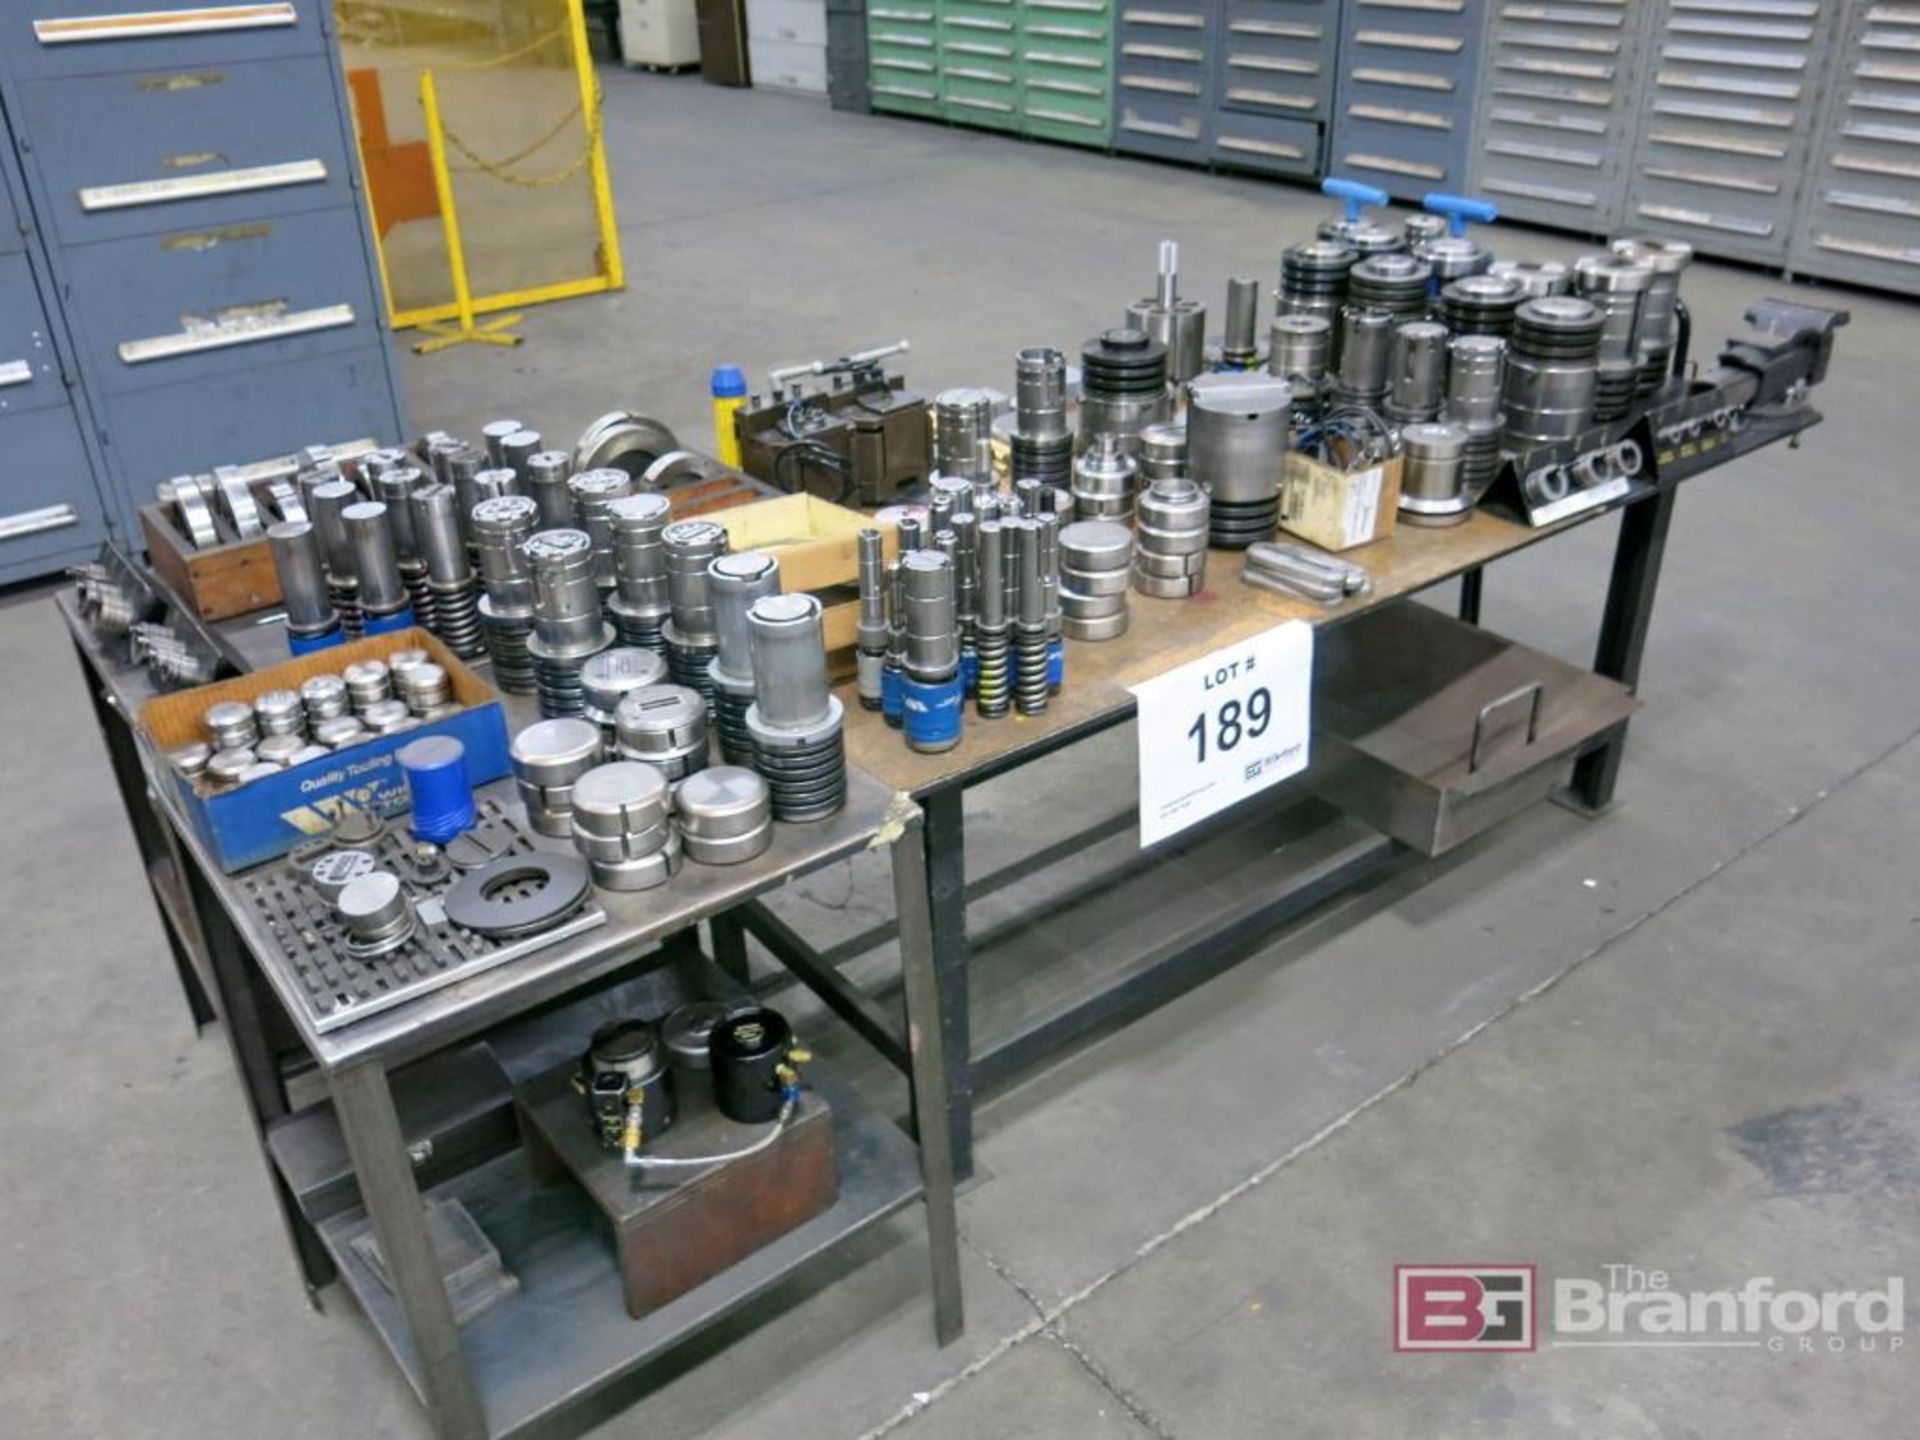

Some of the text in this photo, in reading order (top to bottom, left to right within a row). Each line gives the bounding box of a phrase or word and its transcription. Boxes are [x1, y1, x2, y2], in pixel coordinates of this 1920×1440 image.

[1204, 656, 1256, 689] LOT #
[1188, 687, 1271, 763] 189
[301, 755, 392, 792] Quality Tooling
